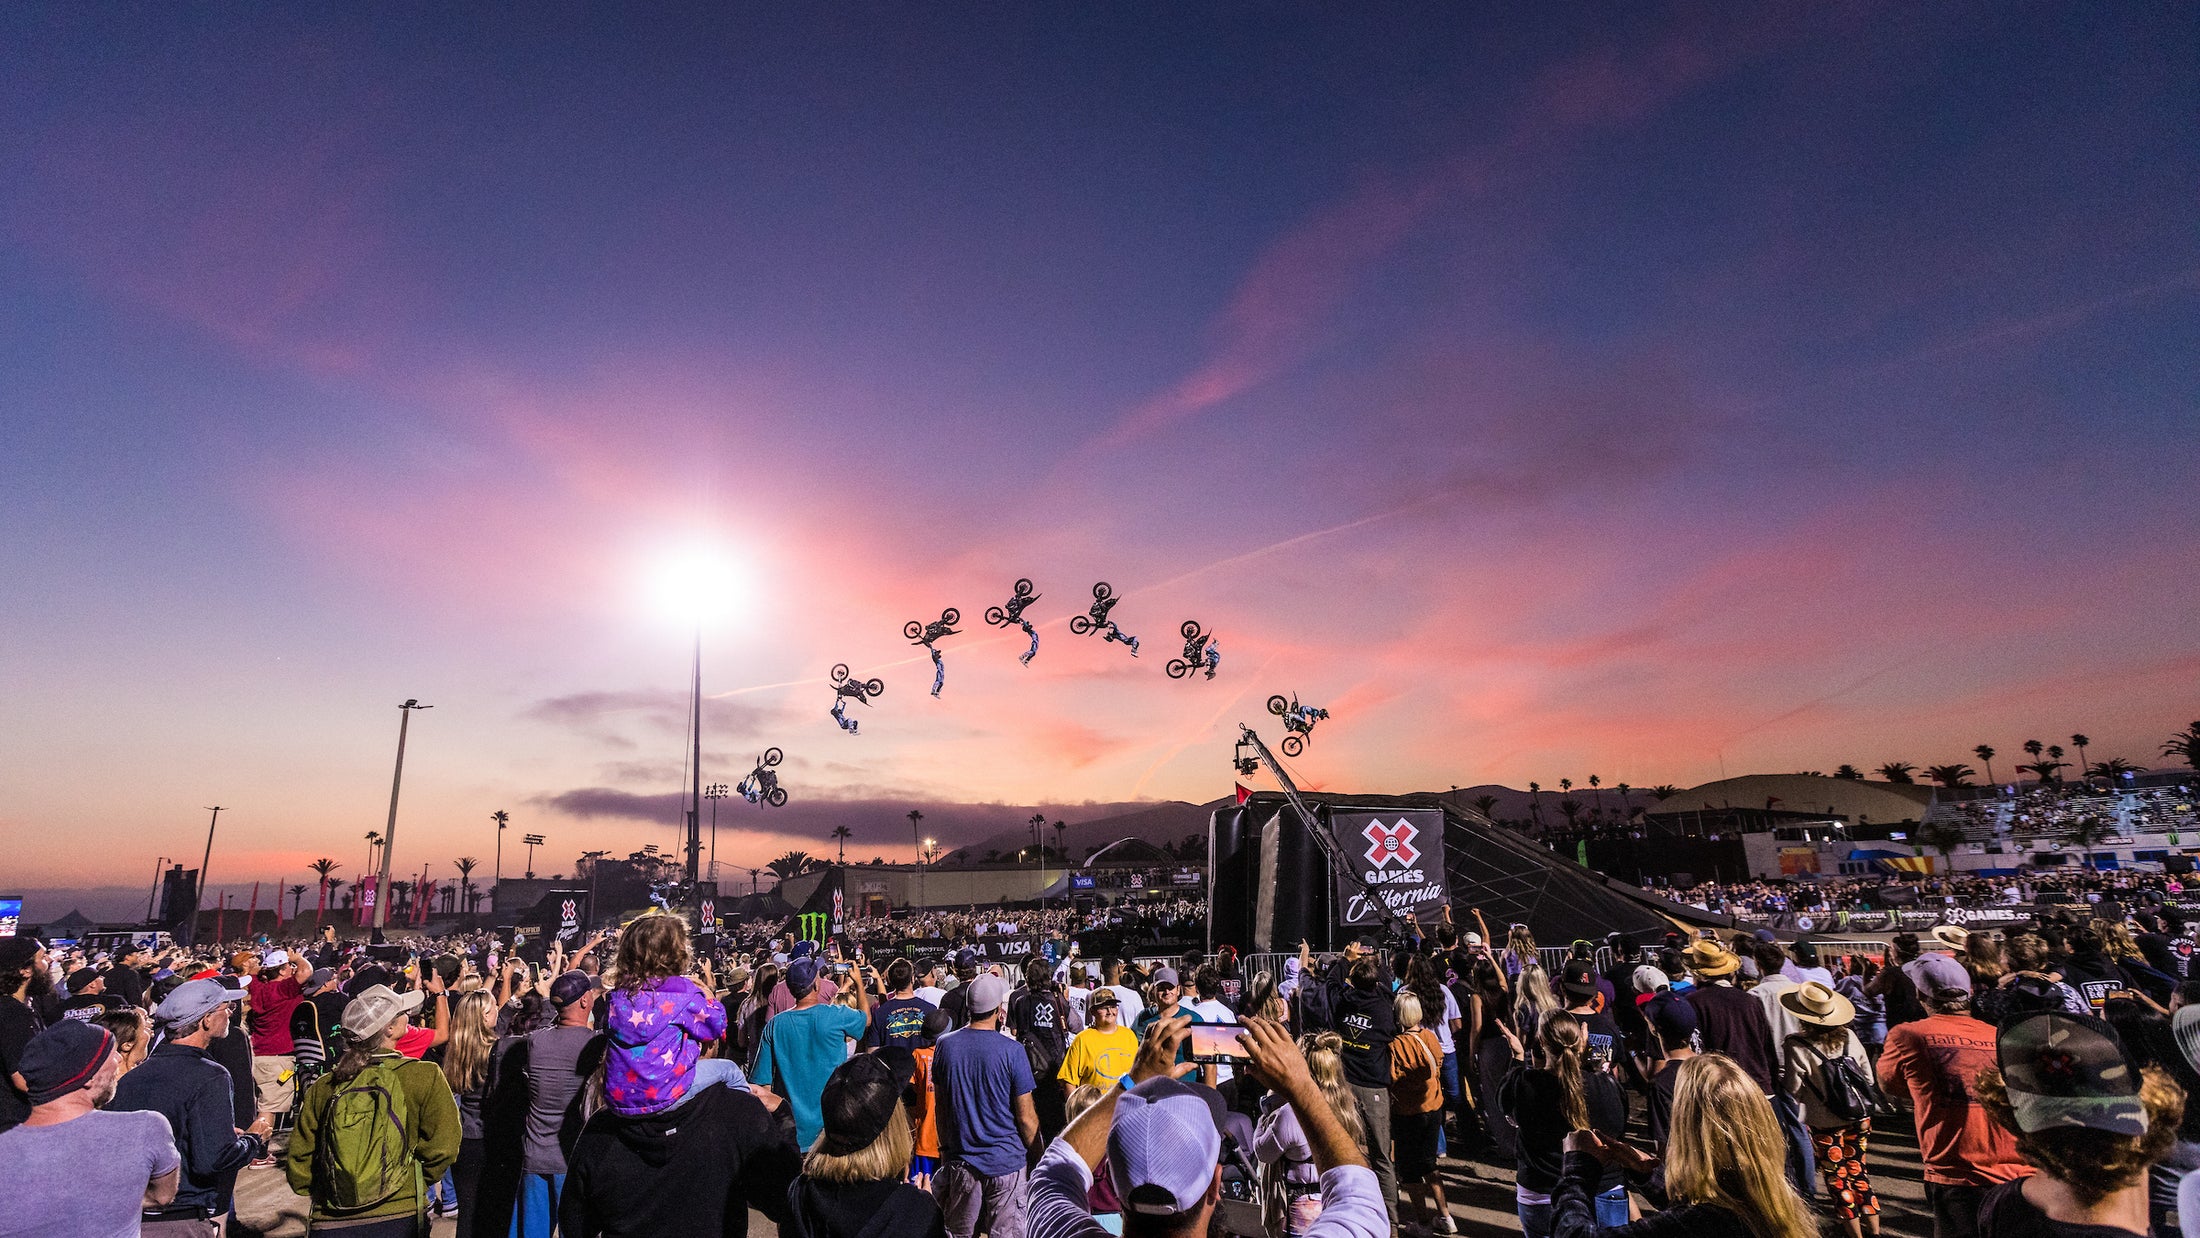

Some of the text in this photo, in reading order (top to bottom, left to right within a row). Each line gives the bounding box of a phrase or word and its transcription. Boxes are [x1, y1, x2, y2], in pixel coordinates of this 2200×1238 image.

[1364, 869, 1425, 884] GAMES
[1346, 882, 1444, 923] Cafornia
[996, 940, 1032, 956] VISA
[63, 1007, 102, 1018] BAKER
[1923, 1035, 1997, 1048] Half Dom
